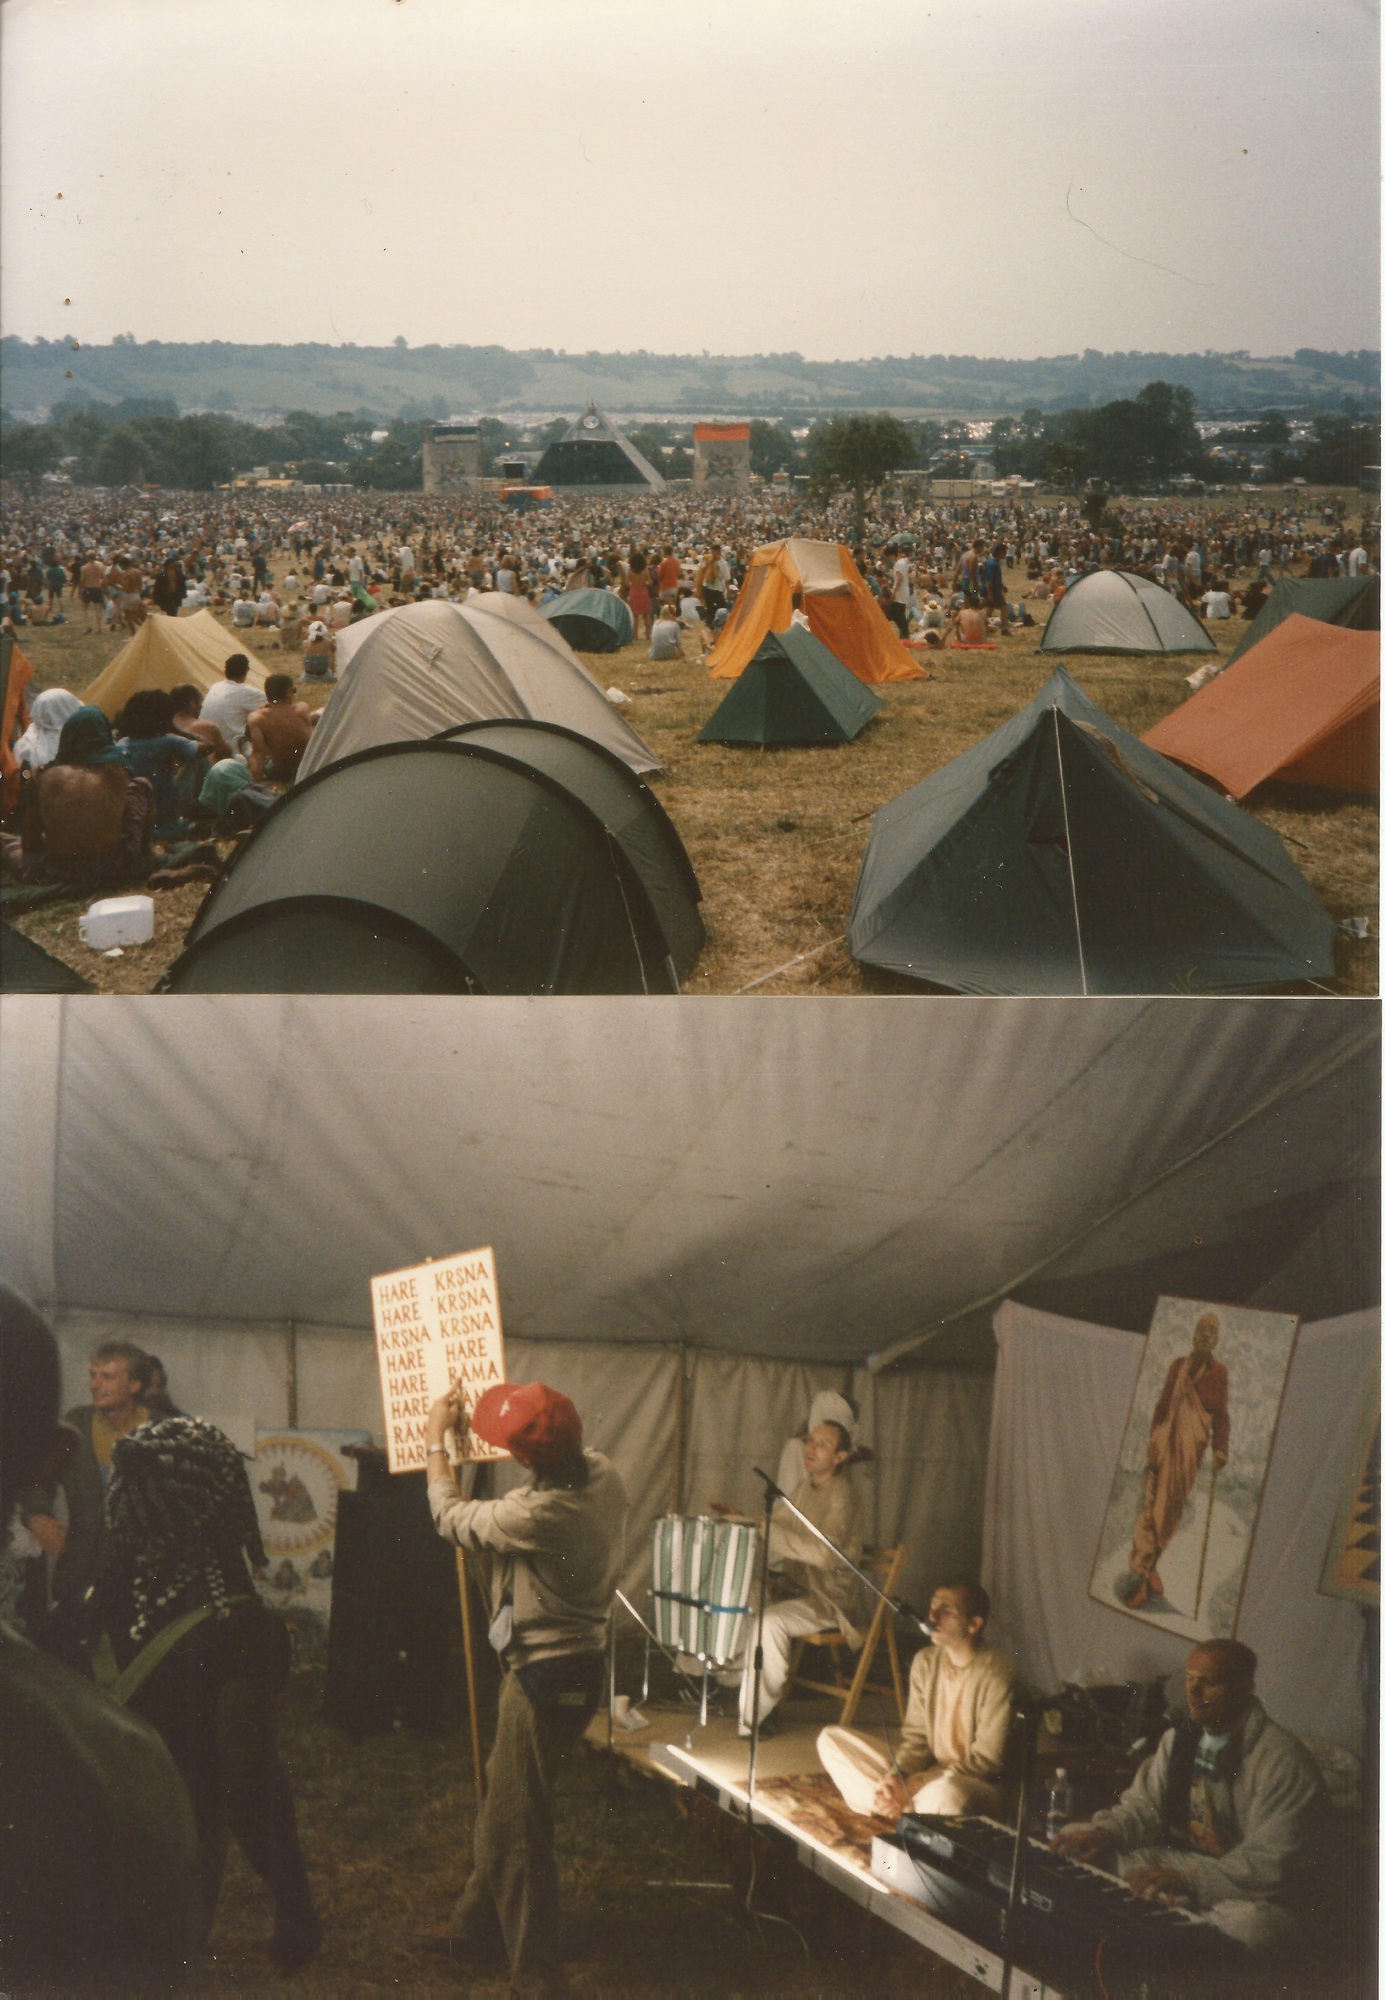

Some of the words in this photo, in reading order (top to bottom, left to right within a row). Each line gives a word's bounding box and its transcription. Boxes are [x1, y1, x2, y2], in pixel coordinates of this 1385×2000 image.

[379, 1278, 418, 1305] HARE
[434, 1261, 489, 1292] KRSNA
[381, 1301, 421, 1329] HARE
[436, 1287, 492, 1315] KRSNA
[380, 1325, 431, 1351] KRSNA
[439, 1311, 495, 1339] KRSNA
[386, 1349, 426, 1375] HARE
[445, 1337, 487, 1363] HARE
[389, 1373, 429, 1397] HARE
[447, 1360, 499, 1386] RAMA
[391, 1396, 429, 1420] HARE
[393, 1421, 428, 1444] RAM
[395, 1445, 426, 1467] HAR
